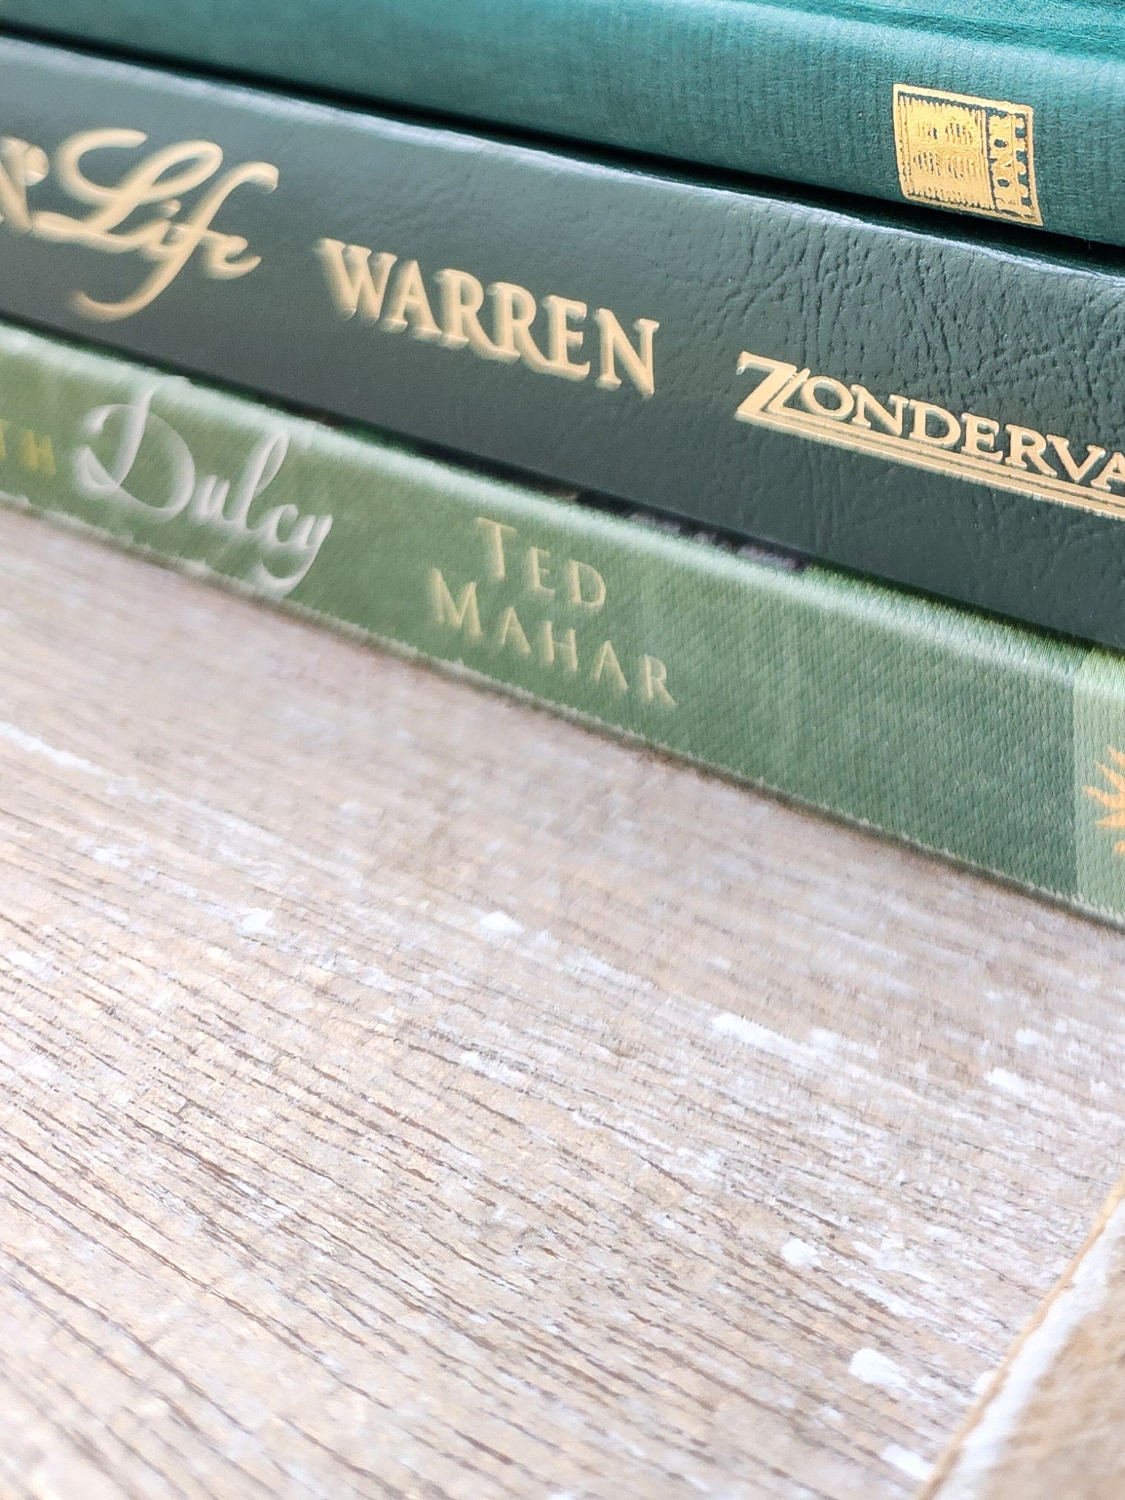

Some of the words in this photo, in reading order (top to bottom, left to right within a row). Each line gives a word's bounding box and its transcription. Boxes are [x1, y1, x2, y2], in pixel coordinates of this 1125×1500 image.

[30, 126, 280, 323] Life
[314, 236, 661, 398] WARREN
[70, 382, 334, 600] Dulcy
[475, 515, 607, 612] TED
[427, 566, 678, 709] MAHAR
